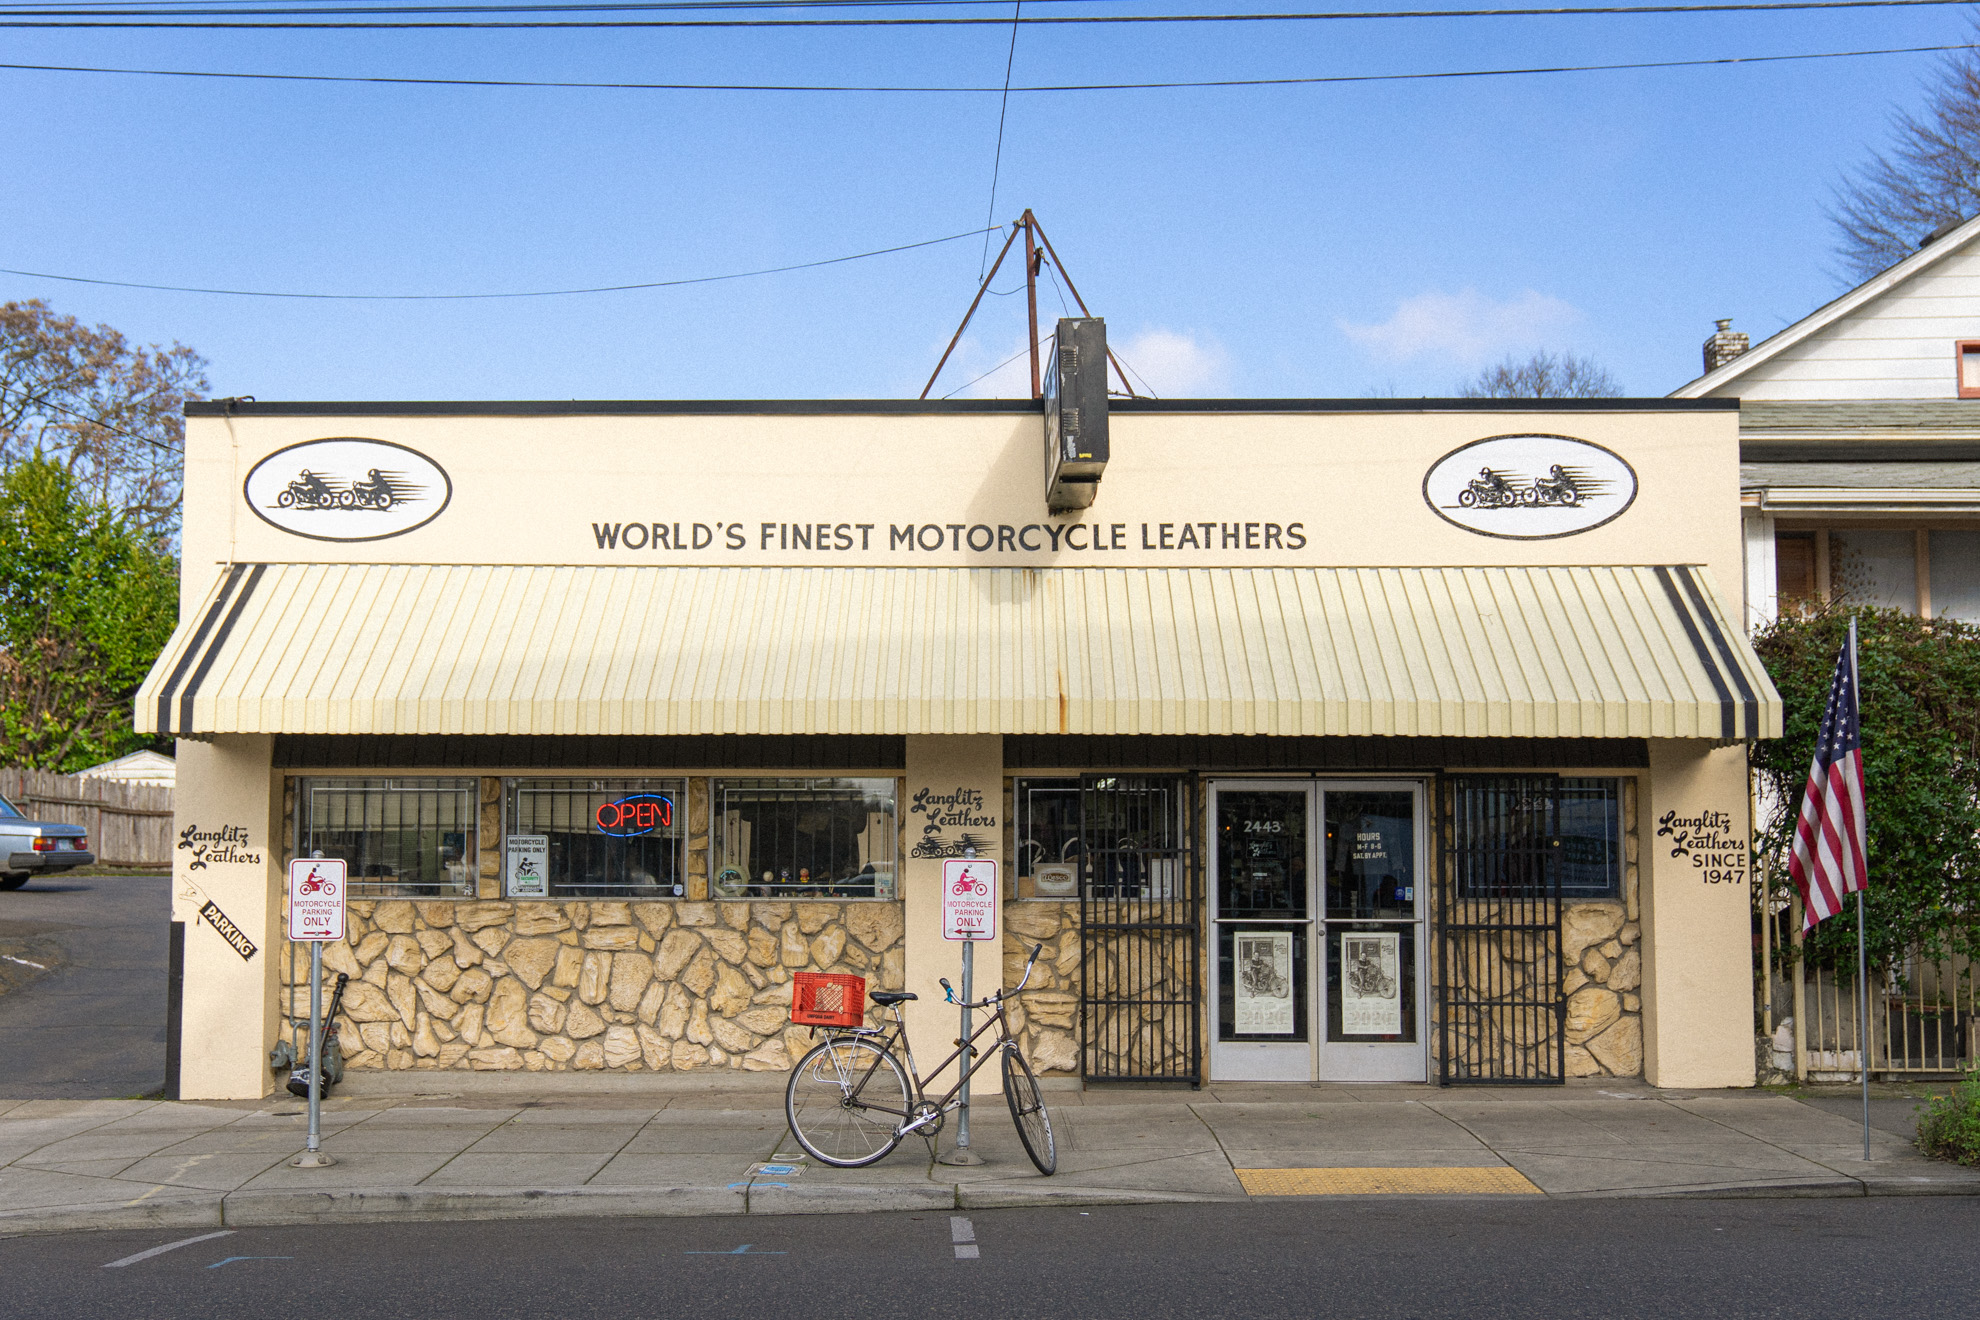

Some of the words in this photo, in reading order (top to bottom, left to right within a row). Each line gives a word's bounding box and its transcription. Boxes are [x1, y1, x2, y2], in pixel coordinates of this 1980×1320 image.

[592, 522, 746, 550] WORLD'S
[761, 523, 874, 550] FINEST
[890, 523, 1126, 552] MOTORCYCLE
[1142, 522, 1307, 550] LEATHERS
[910, 787, 983, 814] Langlitz
[597, 802, 671, 828] OPEN
[923, 808, 996, 834] Leathers
[1243, 820, 1281, 833] 2443
[1657, 810, 1731, 837] Langlitz
[178, 824, 249, 849] Langlitz
[1356, 832, 1381, 841] HOURS
[1671, 831, 1745, 858] Leathers
[190, 844, 261, 870] Leathers
[1693, 854, 1746, 868] SINCE
[1703, 869, 1745, 884] 1947
[293, 900, 341, 908] MOTORCYCLE
[302, 908, 333, 916] PARKING
[203, 904, 254, 957] PARKING
[303, 917, 331, 927] ONLY
[956, 917, 983, 927] ONLY
